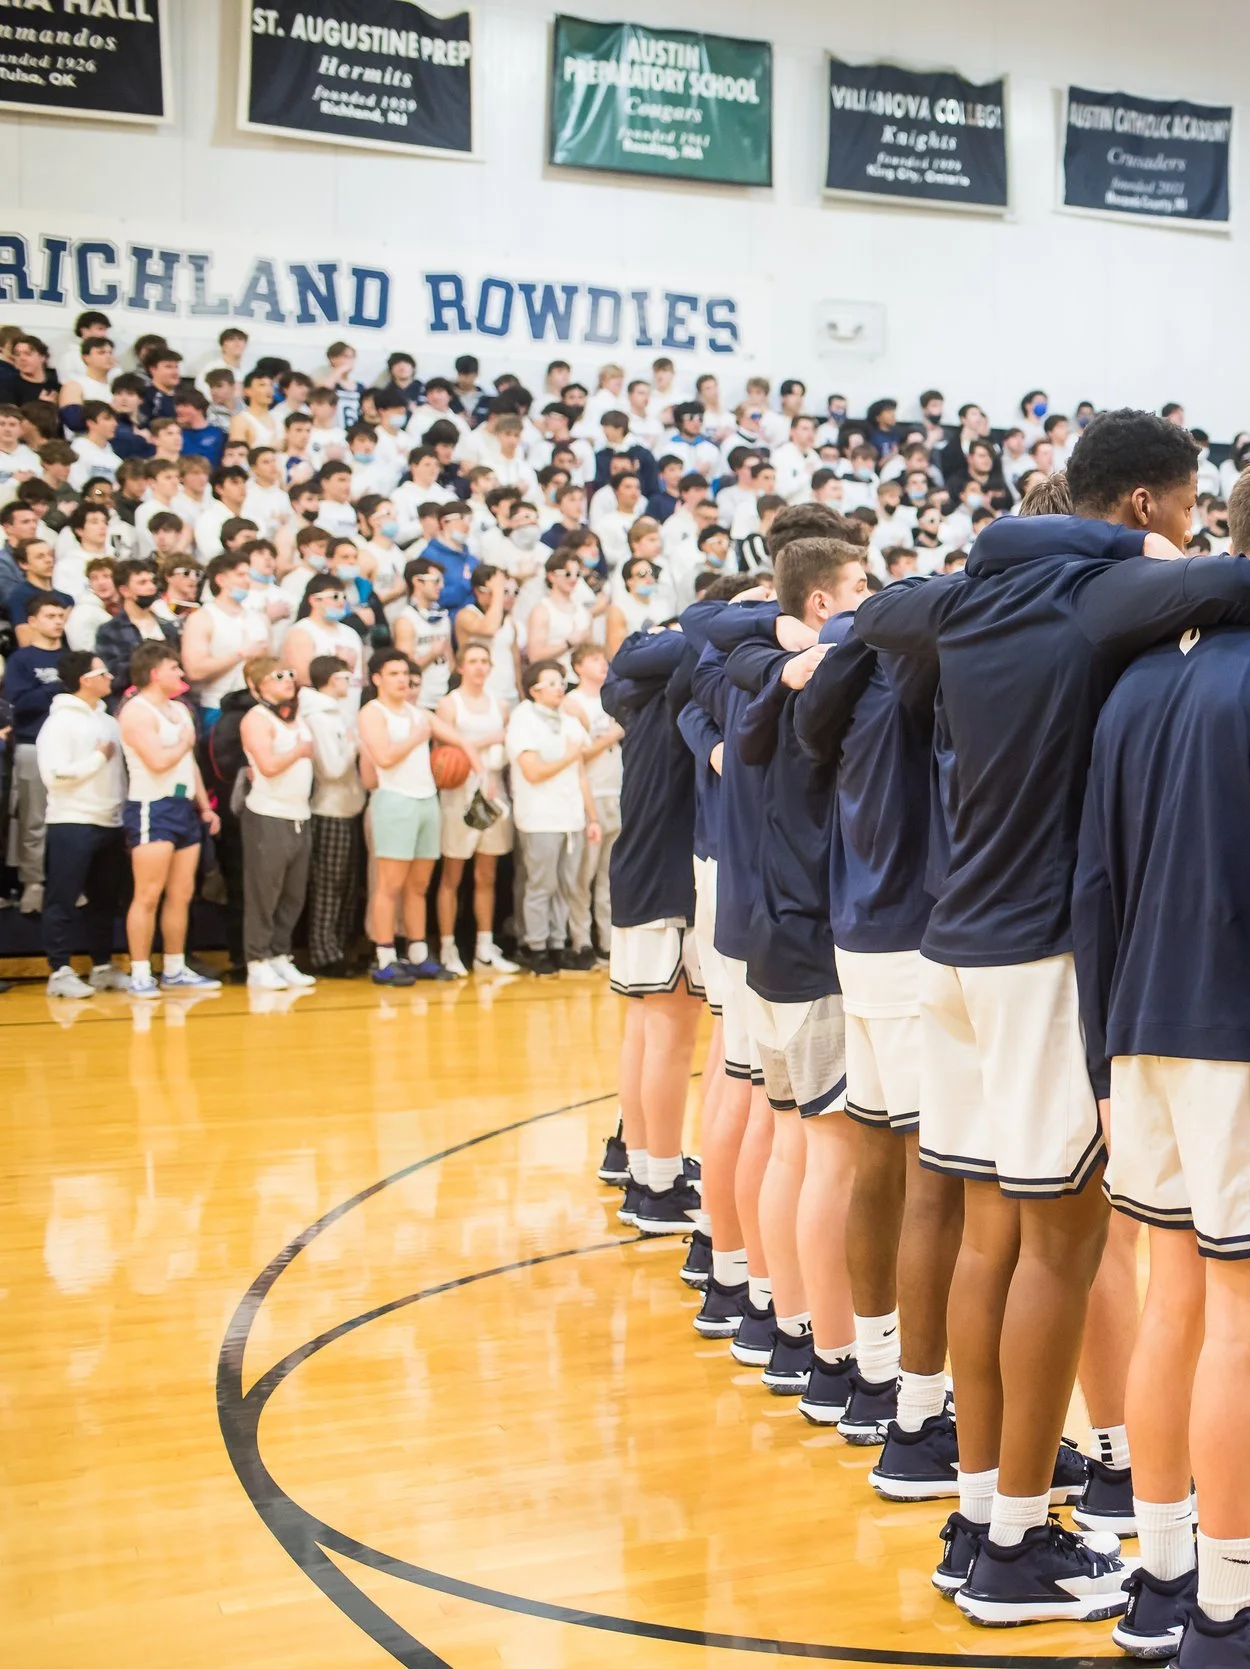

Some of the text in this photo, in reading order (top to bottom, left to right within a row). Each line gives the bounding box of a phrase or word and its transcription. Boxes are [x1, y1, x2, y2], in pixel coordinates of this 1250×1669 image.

[252, 7, 473, 67] ST. AUGUSTINE PREP
[627, 36, 700, 71] AUSTIN
[49, 72, 77, 88] OK
[56, 56, 98, 73] 1926
[317, 54, 413, 88] Hermits
[564, 56, 760, 104] PREPARATORY SCHOOL
[312, 84, 377, 108] founded
[623, 96, 703, 123] Cougars
[830, 84, 931, 121] VILLANOVA
[1069, 102, 1114, 131] AUSTIN
[1114, 107, 1172, 140] CATHOLIC
[881, 125, 957, 152] Knights
[1106, 147, 1188, 172] Crusaders
[0, 232, 740, 353] RICHLAND ROWDIES
